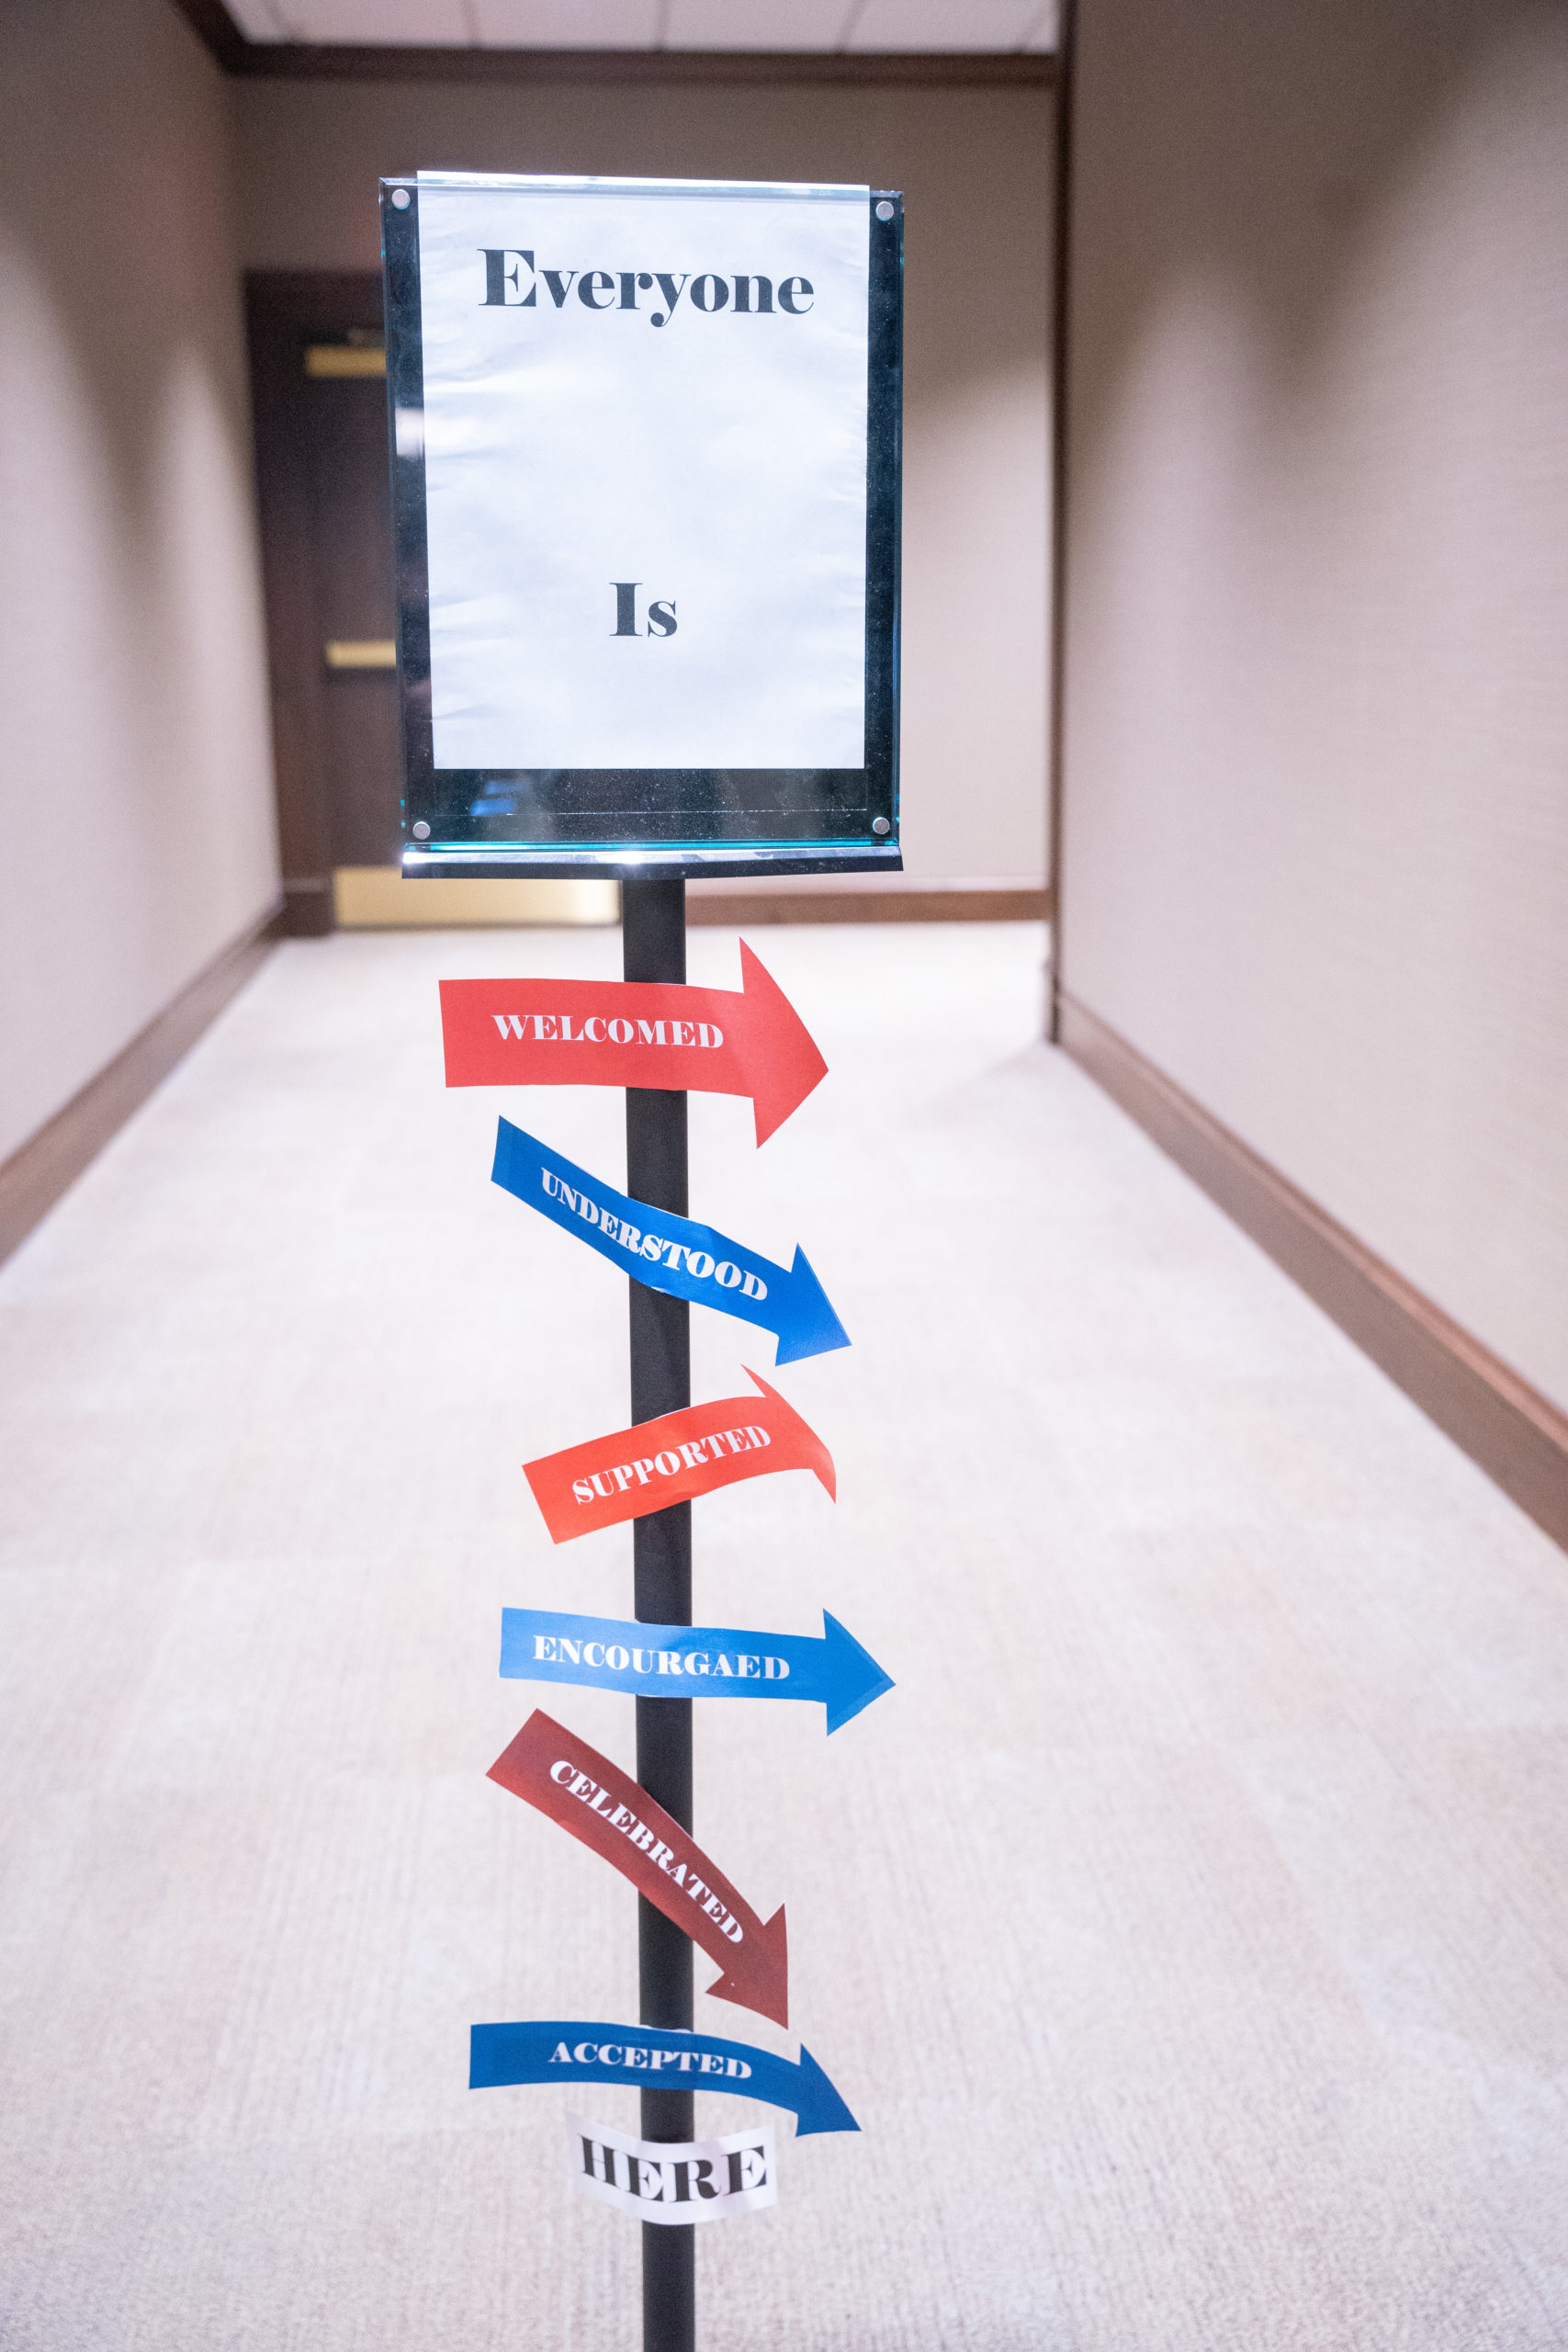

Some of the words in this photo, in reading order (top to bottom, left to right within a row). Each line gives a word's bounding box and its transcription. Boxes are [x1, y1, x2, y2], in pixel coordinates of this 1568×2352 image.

[477, 248, 815, 328] Everyone
[608, 582, 678, 639] Is
[491, 1014, 724, 1049] WELCOMED
[541, 1167, 768, 1301] UNDERSTOOD
[571, 1425, 772, 1506] SUPPORTED
[533, 1634, 791, 1680] ENCOURGAED
[550, 1759, 744, 1944] CELEBRATED
[549, 2042, 752, 2079] ACCEPTED
[578, 2133, 768, 2202] HERE
